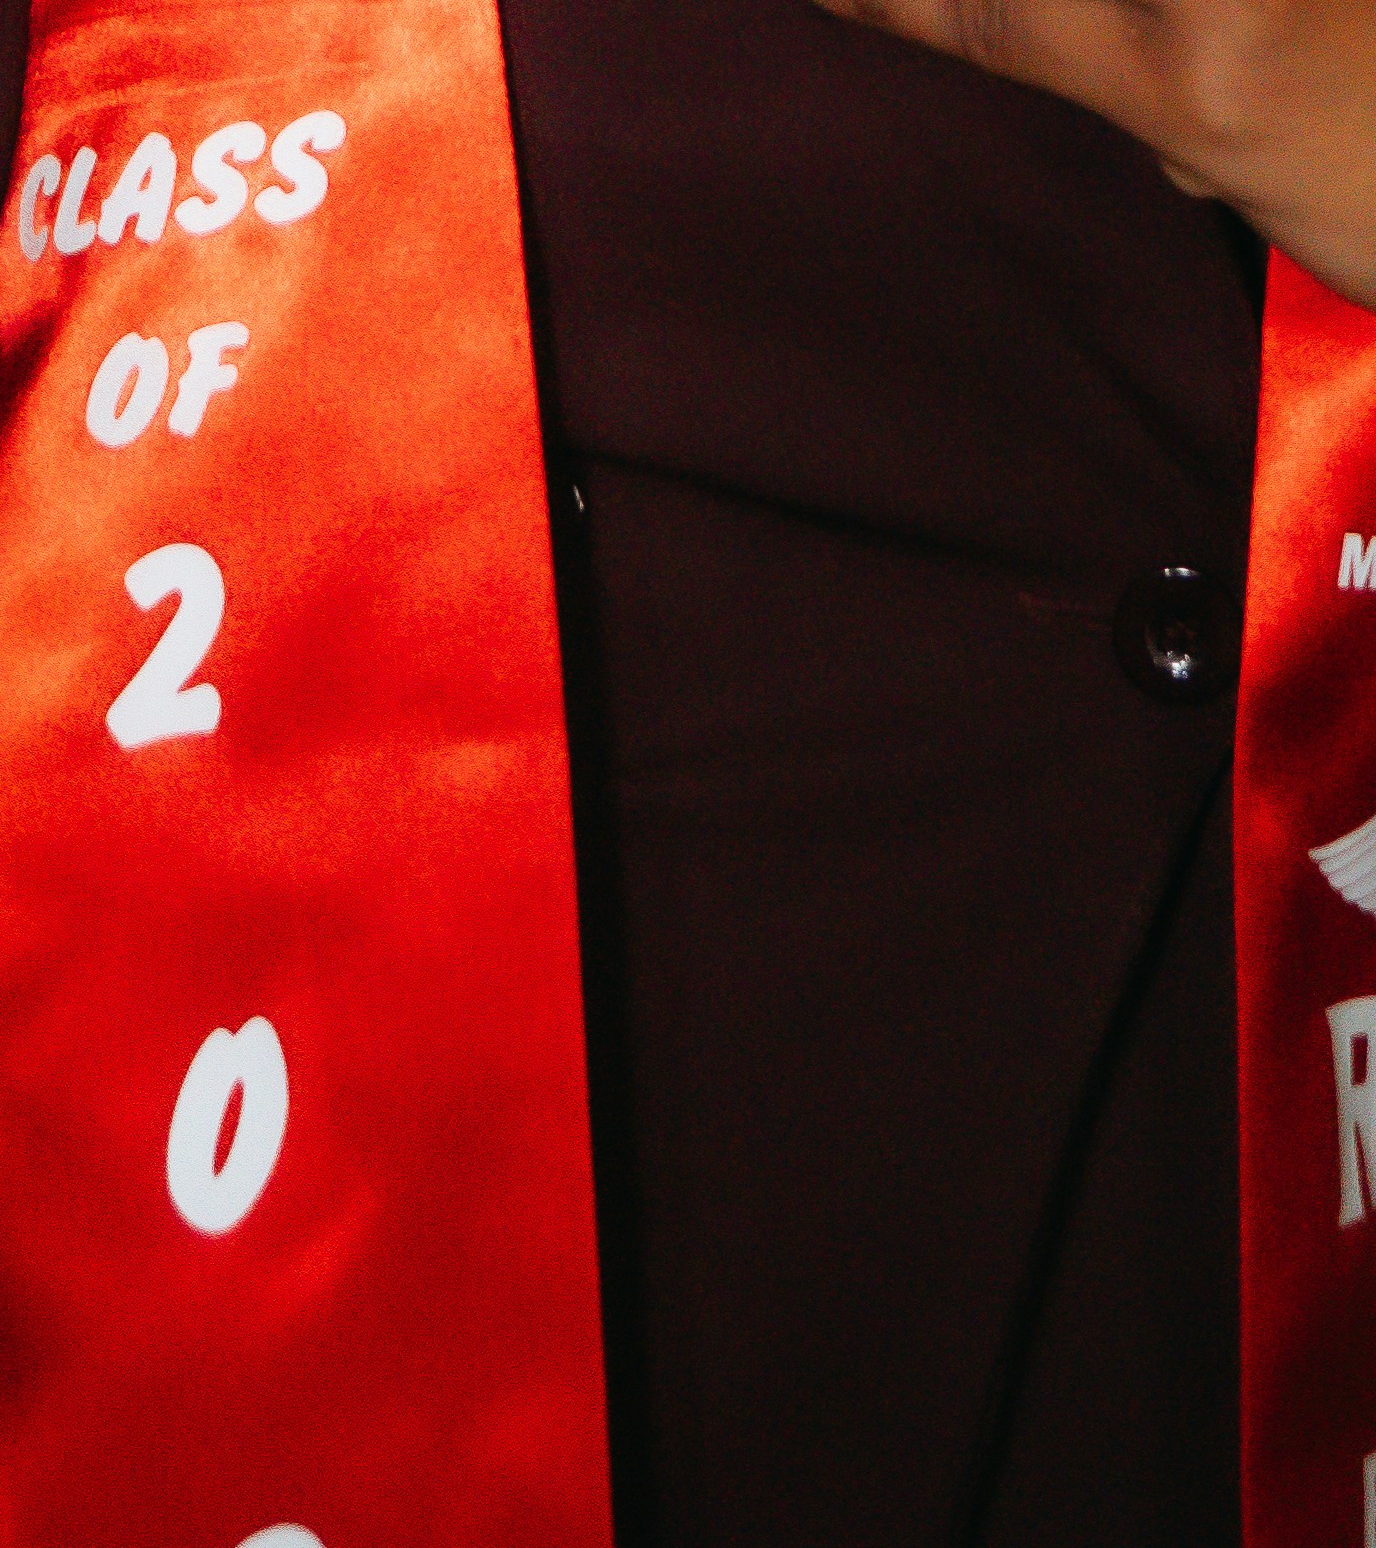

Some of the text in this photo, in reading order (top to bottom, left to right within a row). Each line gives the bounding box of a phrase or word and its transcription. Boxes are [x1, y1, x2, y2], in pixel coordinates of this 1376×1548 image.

[19, 108, 346, 261] CLASS
[85, 321, 249, 450] OF
[106, 542, 224, 750] 2
[166, 1014, 291, 1235] 0
